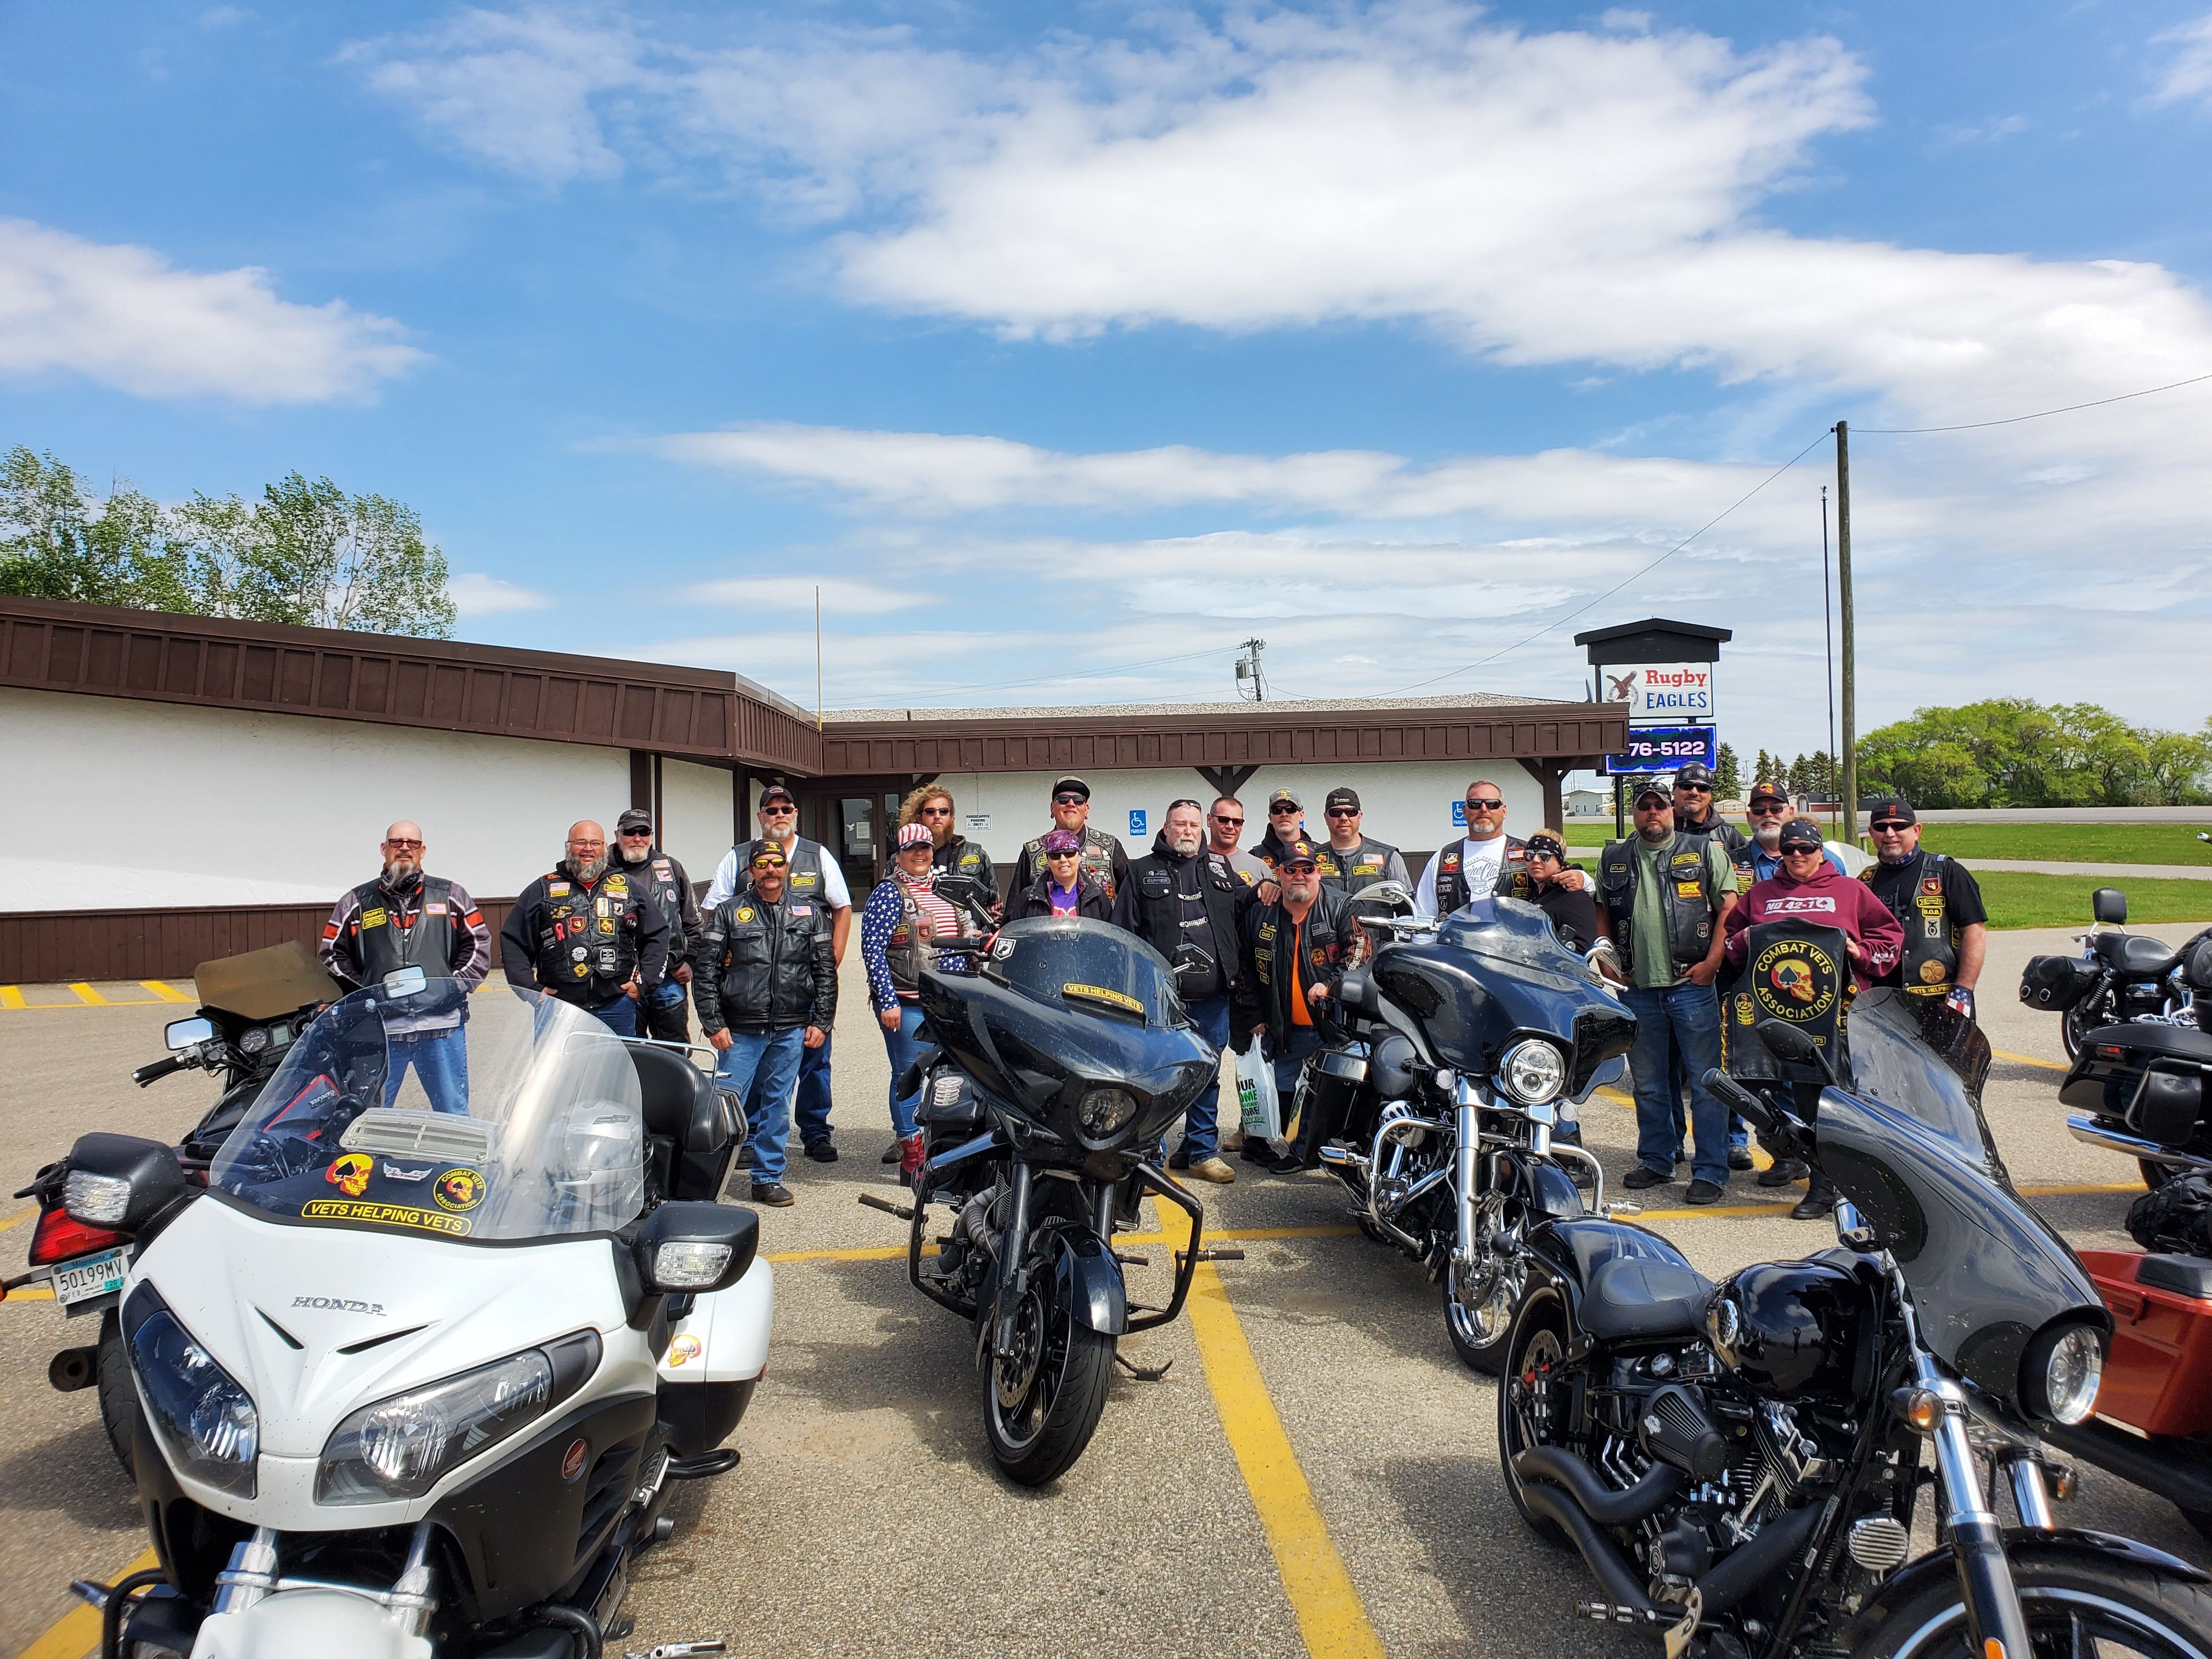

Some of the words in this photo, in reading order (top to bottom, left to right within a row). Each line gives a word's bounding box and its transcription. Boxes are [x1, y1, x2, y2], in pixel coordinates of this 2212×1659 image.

[1645, 669, 1707, 687] Rugby
[1646, 691, 1707, 709] EAGLES
[1629, 741, 1705, 757] 76-5122
[1464, 855, 1501, 866] ARLEY-DAVIDS
[365, 909, 382, 918] PAPPY
[1766, 902, 1782, 911] ND
[1784, 900, 1814, 910] 42-1
[1311, 952, 1324, 962] 22
[1758, 943, 1808, 972] COMBAT
[1809, 947, 1832, 974] VETS
[1090, 988, 1123, 1001] HELPING
[1124, 997, 1141, 1009] VETS
[1239, 1089, 1257, 1103] OME
[441, 1170, 473, 1182] COMBAT
[471, 1175, 483, 1190] VETS
[437, 1193, 477, 1210] ASSOCIATION
[311, 1203, 349, 1215] VETS
[351, 1205, 420, 1223] HELPING
[424, 1214, 464, 1232] VETS
[73, 1255, 105, 1267] Minnesota
[59, 1258, 122, 1291] 50199MV
[67, 1290, 81, 1299] FEB
[291, 1296, 387, 1316] HONDA
